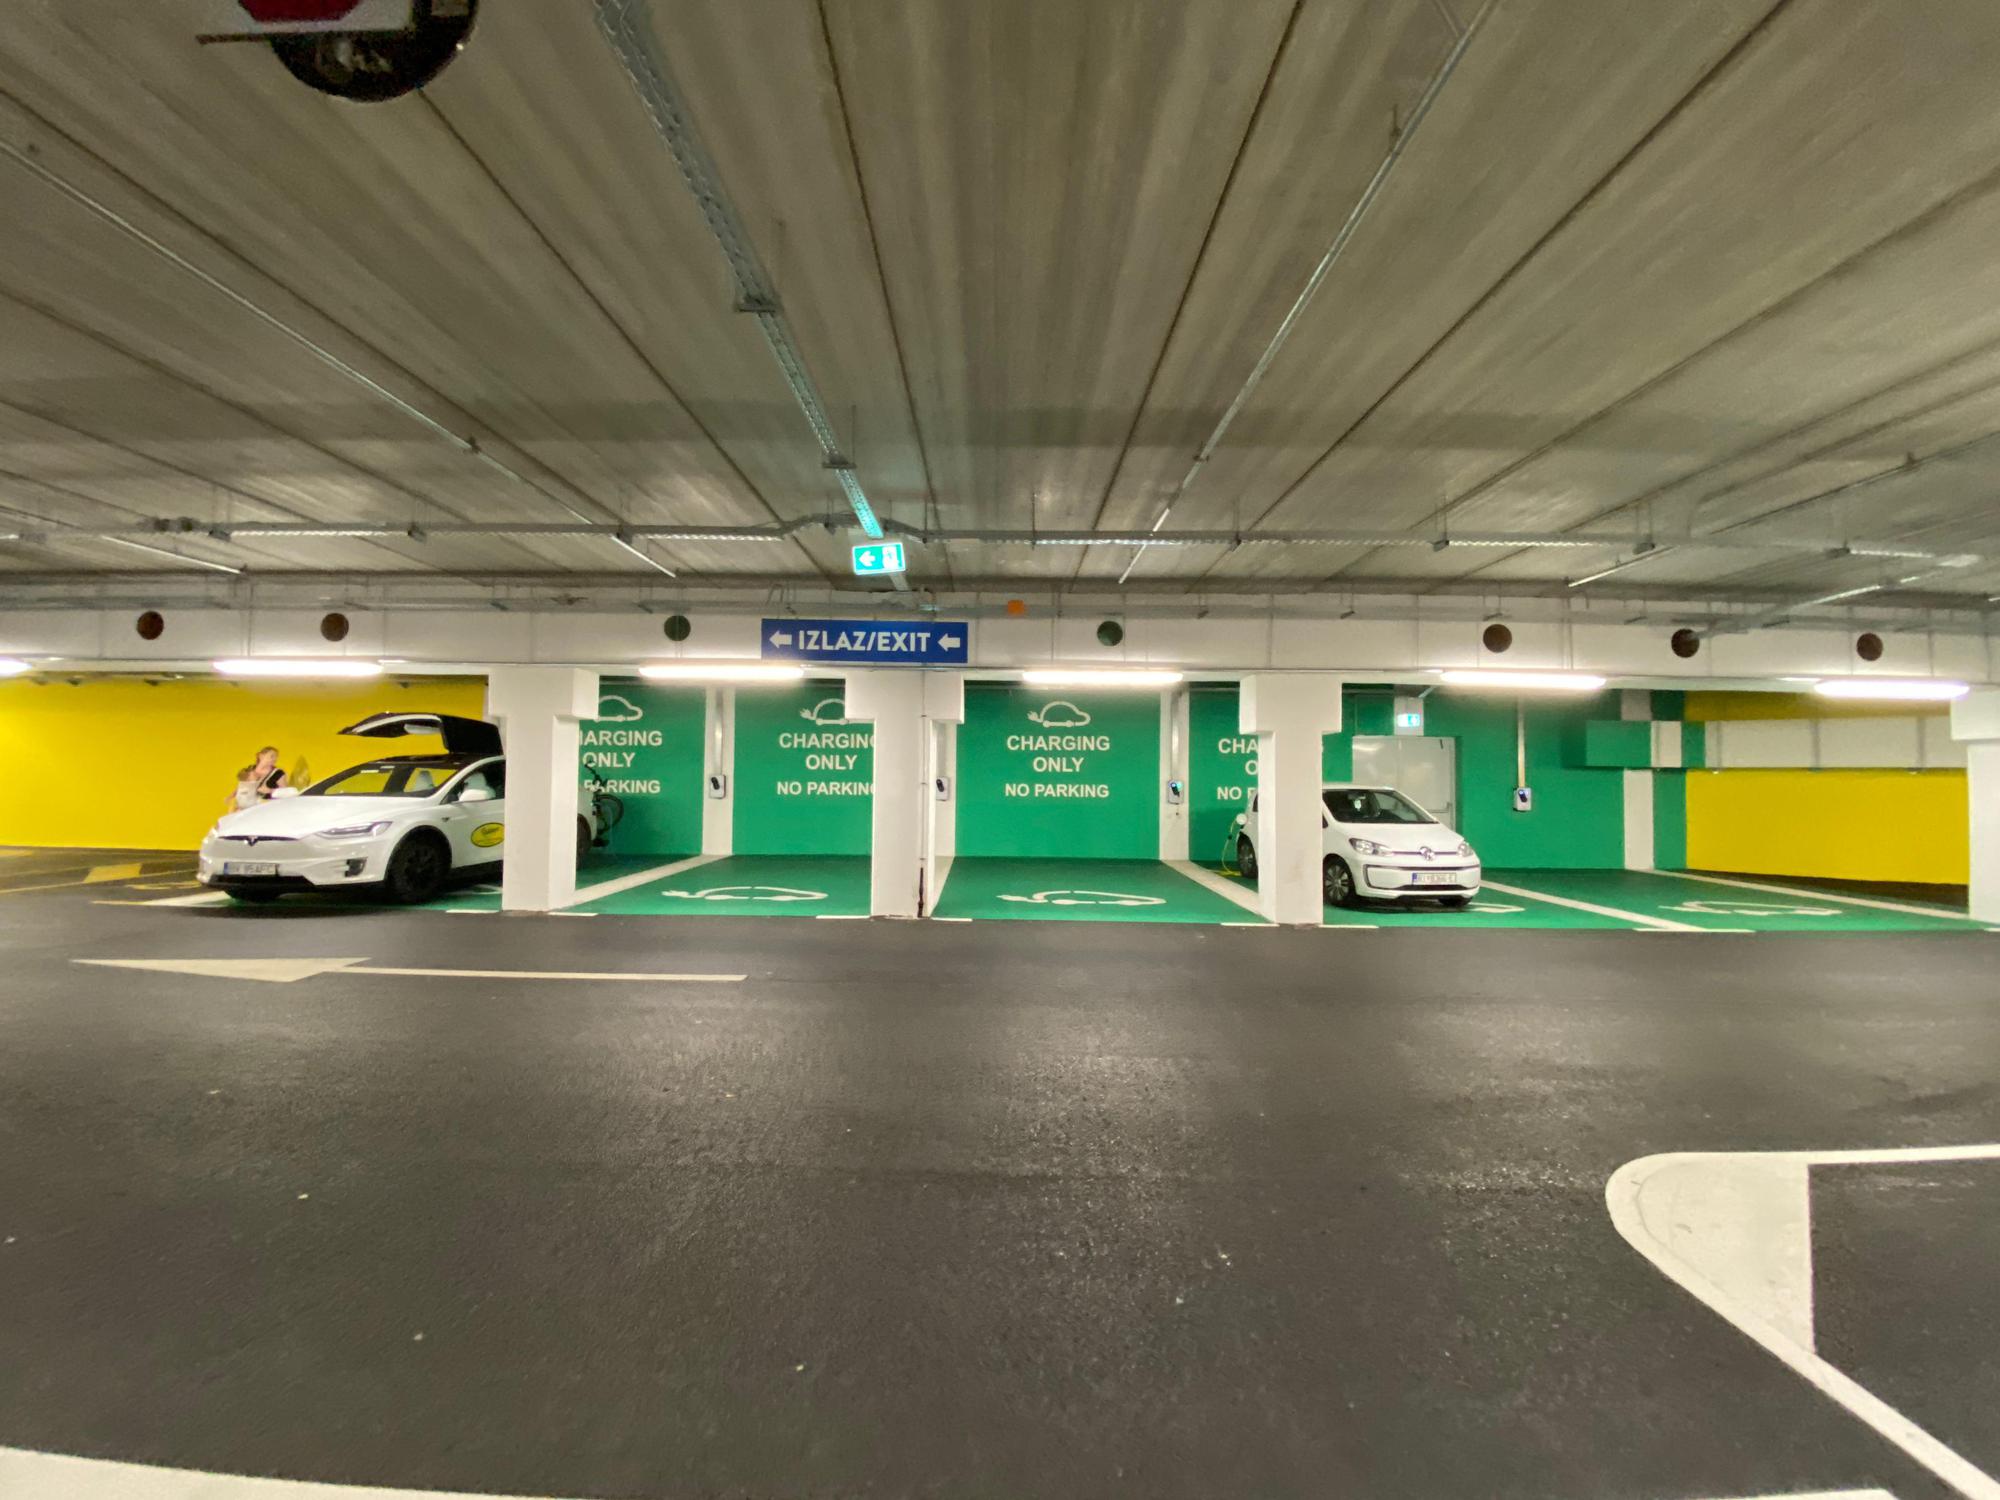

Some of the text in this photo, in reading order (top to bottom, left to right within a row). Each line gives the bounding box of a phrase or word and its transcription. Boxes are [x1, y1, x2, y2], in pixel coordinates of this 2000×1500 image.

[799, 630, 931, 652] IZLAZ/EXIT
[579, 730, 663, 746] ARGING
[1006, 735, 1111, 751] CHARGING
[582, 751, 636, 768] ONLY
[805, 754, 858, 770] ONLY
[1033, 756, 1084, 773] ONLY
[777, 781, 802, 795] NO
[1005, 783, 1110, 798] NO PARKING
[1216, 786, 1242, 800] NO
